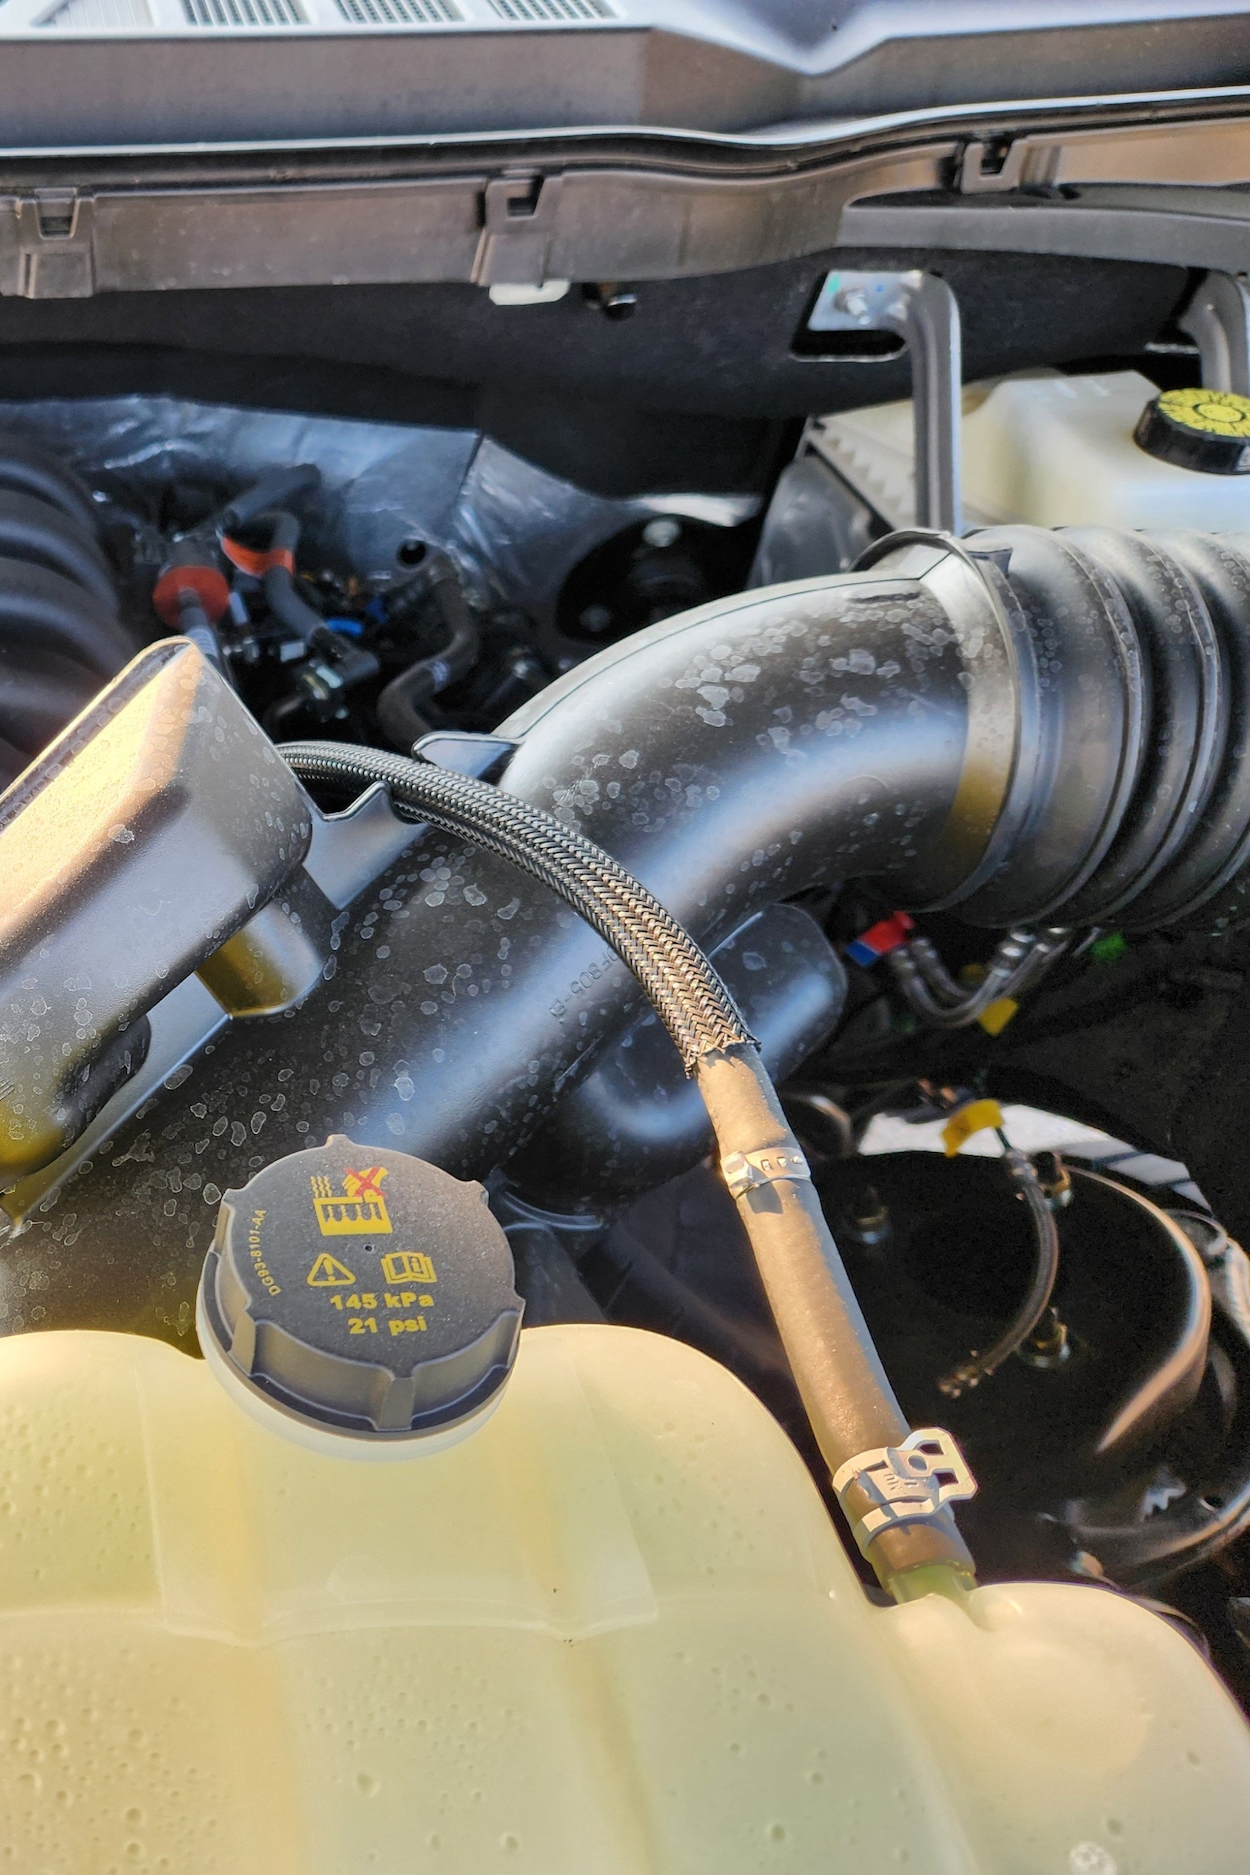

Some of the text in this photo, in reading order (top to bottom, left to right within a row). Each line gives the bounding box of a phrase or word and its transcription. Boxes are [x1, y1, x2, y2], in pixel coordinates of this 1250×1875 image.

[249, 1209, 282, 1297] DG93-8101-AA
[330, 1292, 434, 1310] 145 kPa
[348, 1315, 427, 1336] 21 psi
